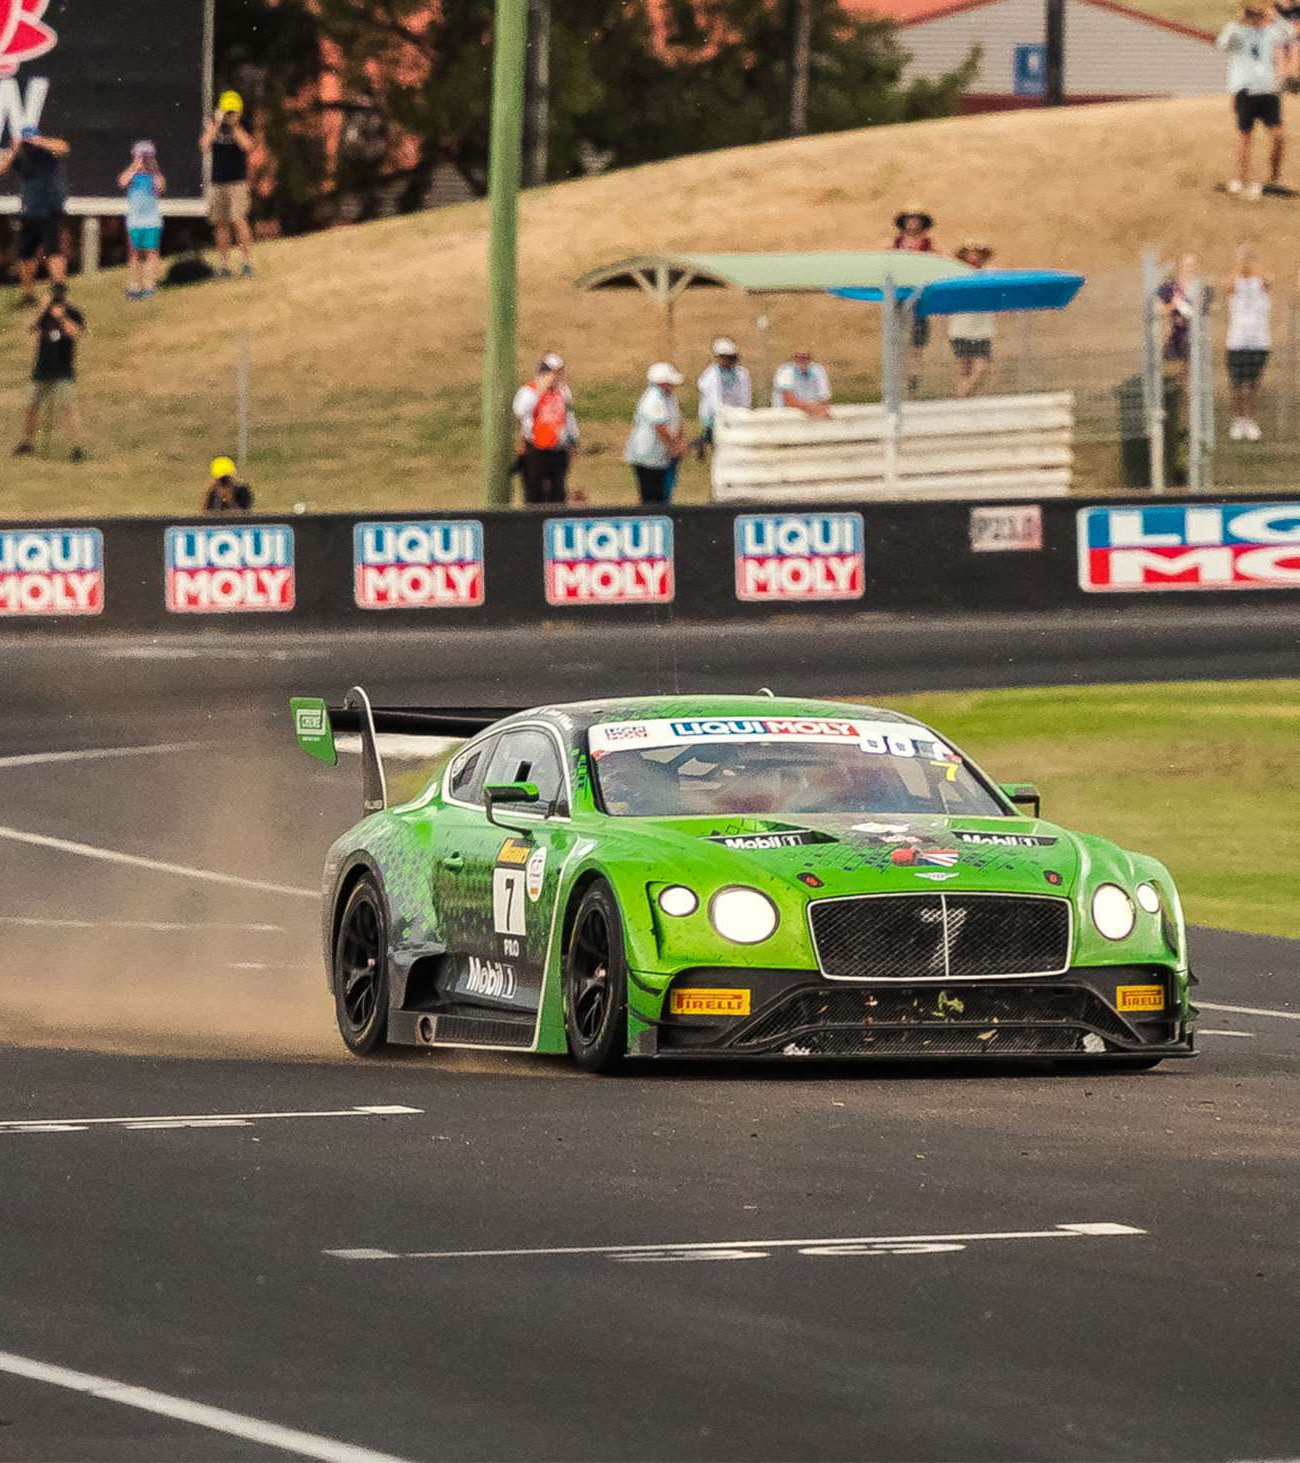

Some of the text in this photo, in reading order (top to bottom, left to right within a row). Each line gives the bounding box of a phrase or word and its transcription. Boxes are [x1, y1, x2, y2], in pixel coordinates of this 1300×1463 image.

[175, 530, 283, 567] LIQUI
[364, 525, 472, 563] LIQUI
[554, 521, 662, 559] LIQUI
[744, 517, 852, 554] LIQUI
[174, 568, 289, 606] MOLY
[364, 563, 478, 602] MOLY
[553, 560, 668, 598] MOLY
[744, 556, 858, 592] MOLY
[674, 720, 858, 736] LIQUI MOLY
[929, 759, 959, 782] 7
[724, 835, 780, 849] Mobil
[962, 834, 1018, 847] Mobil
[505, 878, 515, 932] 7
[466, 956, 503, 997] Mobil
[676, 993, 743, 1009] PIRELLI
[1123, 990, 1162, 1006] PIRELLI
